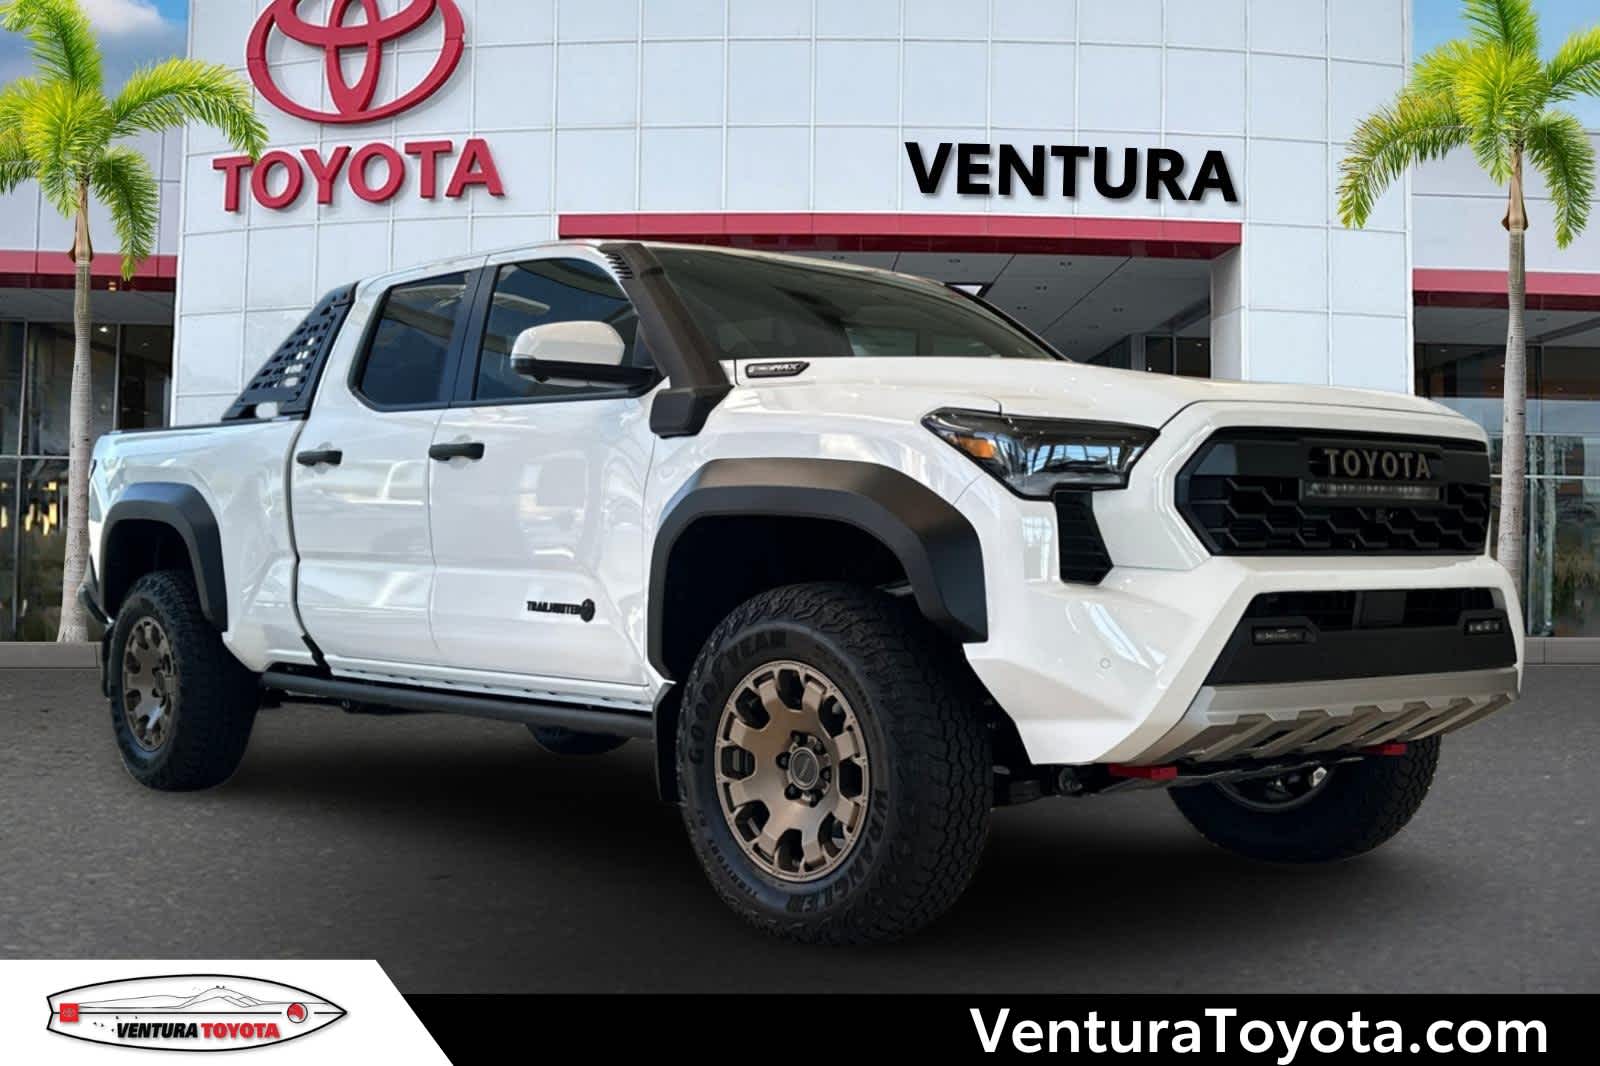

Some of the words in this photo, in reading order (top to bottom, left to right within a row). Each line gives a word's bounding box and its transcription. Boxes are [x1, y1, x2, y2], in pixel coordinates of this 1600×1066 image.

[213, 139, 504, 211] TOYOTA
[905, 142, 1237, 202] VENTURA
[1324, 449, 1432, 479] TOYOTA
